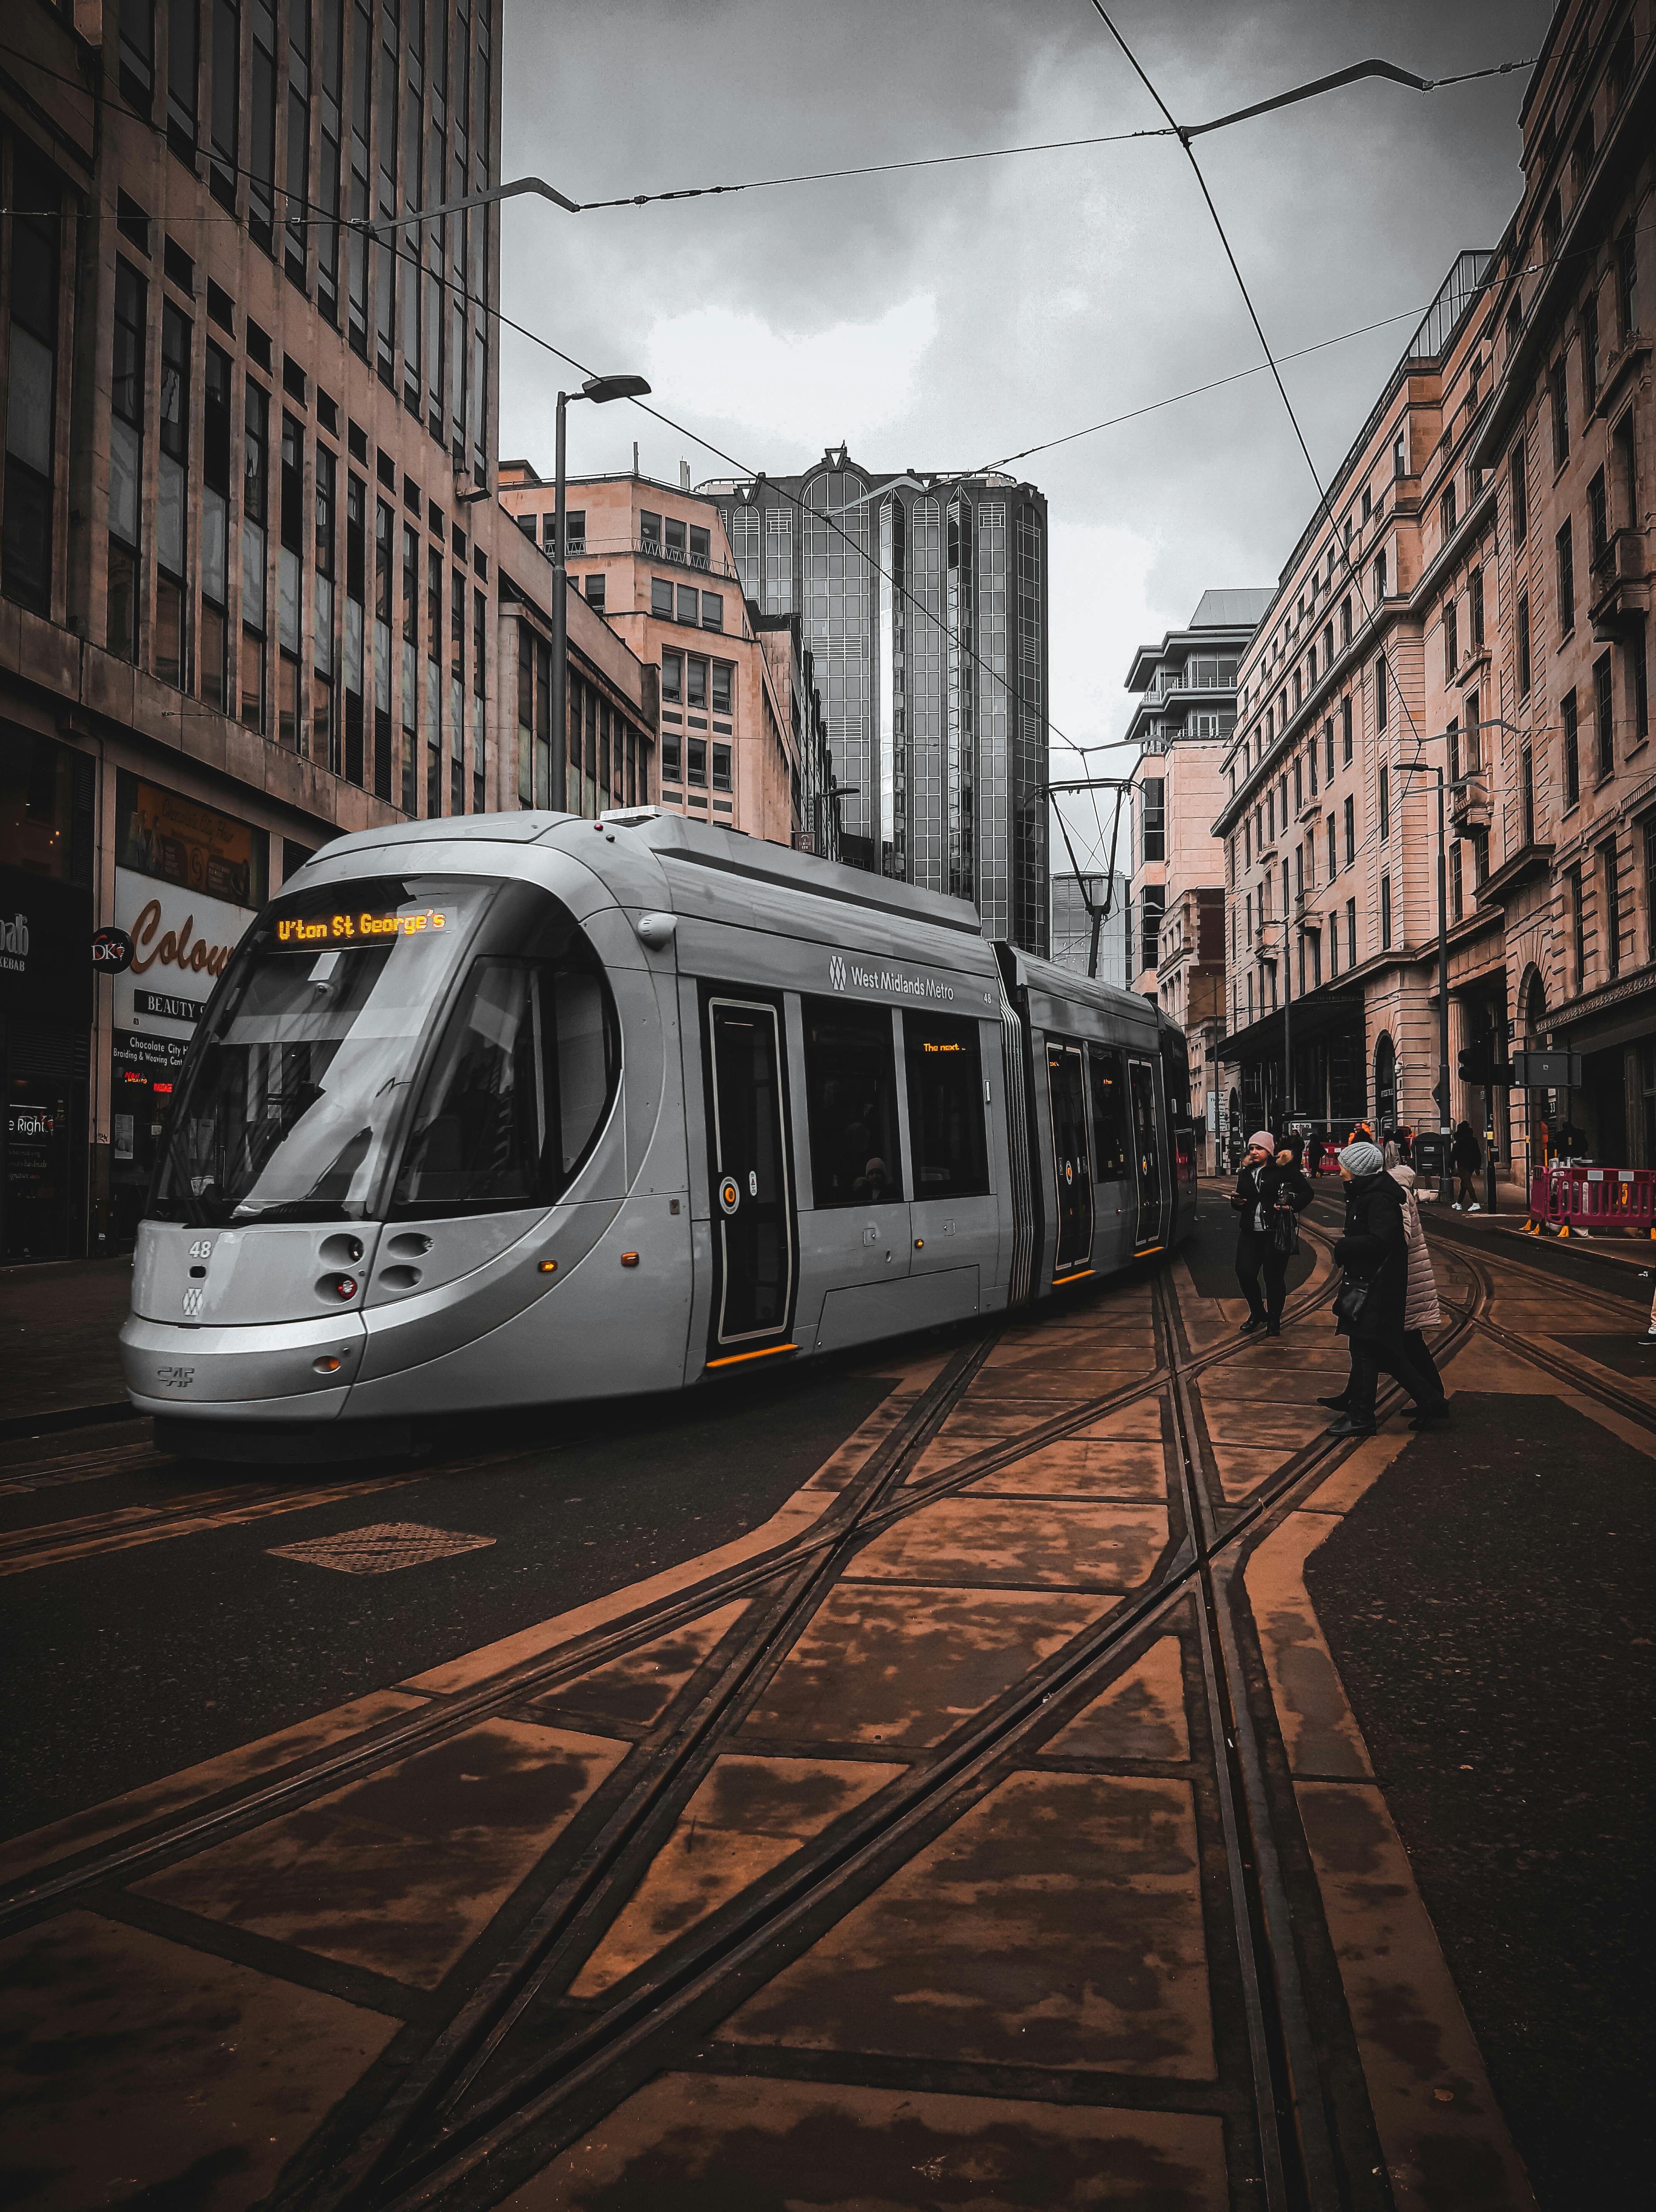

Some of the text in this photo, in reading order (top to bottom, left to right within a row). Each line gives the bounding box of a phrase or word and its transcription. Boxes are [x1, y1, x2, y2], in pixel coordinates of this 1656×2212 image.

[333, 915, 354, 936] St
[360, 909, 445, 935] George's
[851, 966, 954, 1000] West Midlands Metro
[147, 995, 195, 1018] BEAUTY
[984, 993, 992, 1004] 48
[130, 1037, 165, 1052] Chocolate
[168, 1043, 181, 1057] City
[923, 1043, 938, 1052] The
[113, 1048, 137, 1061] Braiding
[139, 1051, 144, 1061] &
[145, 1052, 168, 1066] Weaving
[188, 1240, 212, 1258] 48
